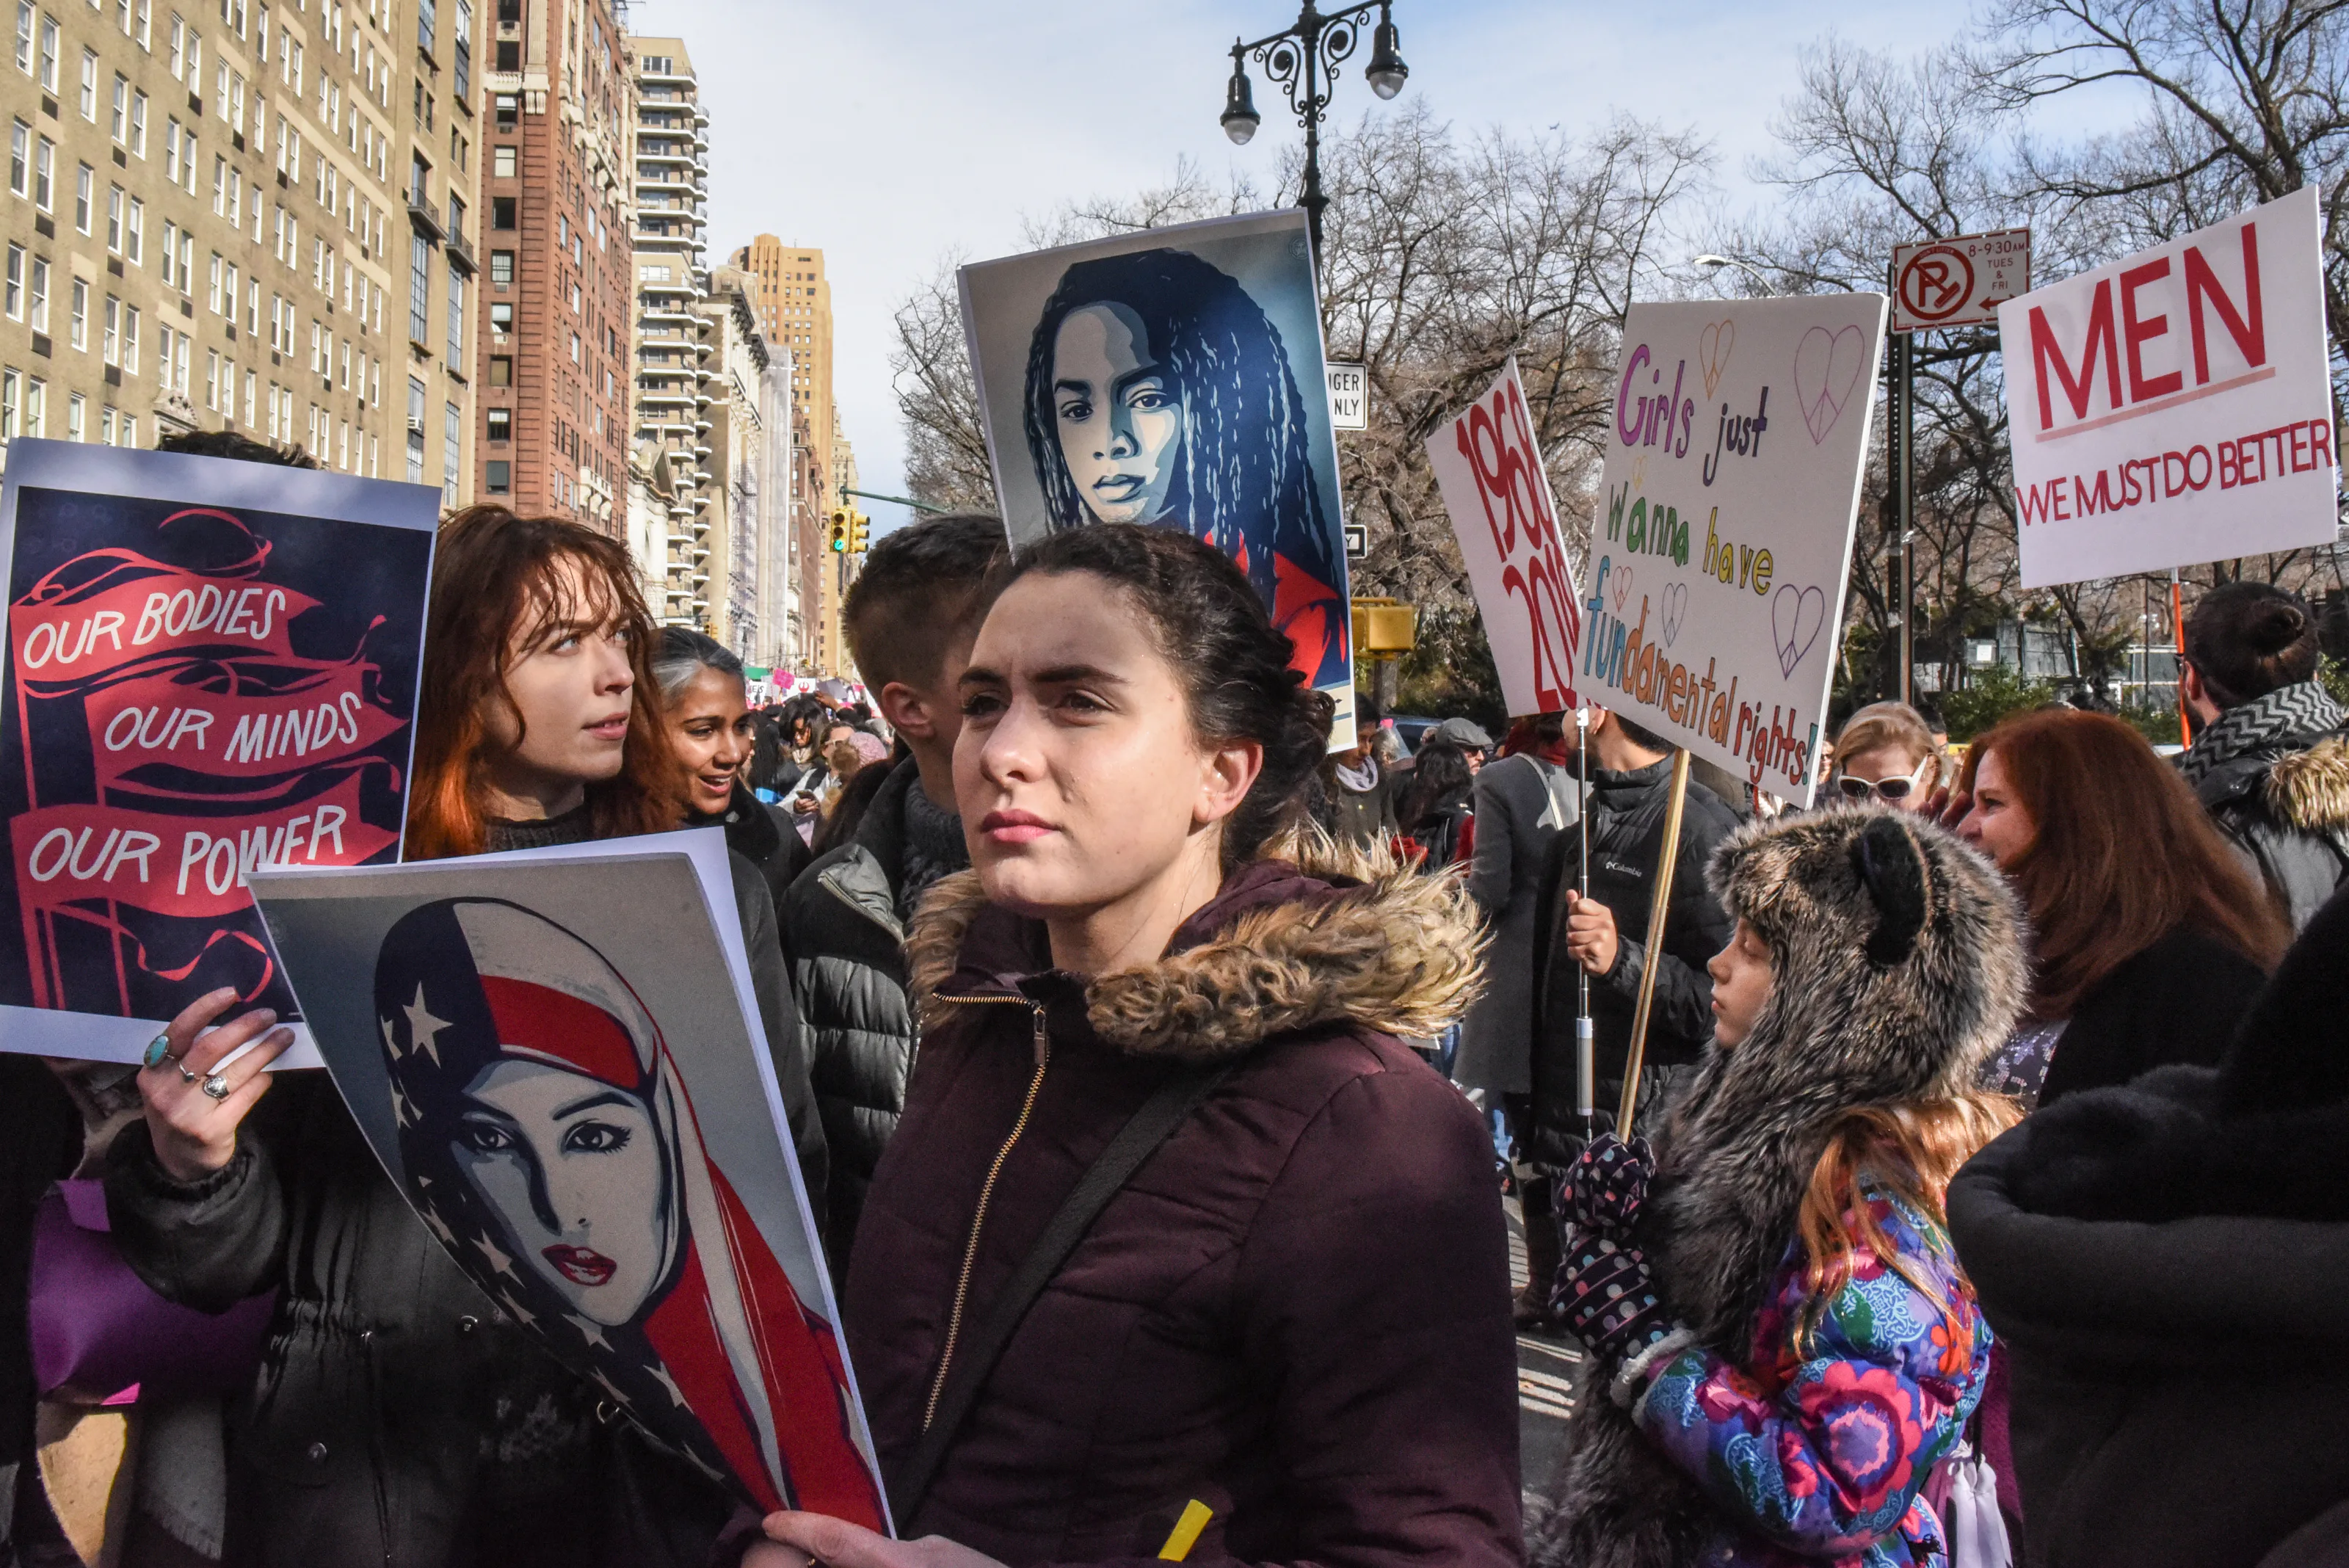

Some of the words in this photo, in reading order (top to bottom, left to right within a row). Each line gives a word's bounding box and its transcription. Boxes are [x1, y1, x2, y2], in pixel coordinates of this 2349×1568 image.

[1988, 258, 2014, 268] TUES
[1992, 280, 2008, 291] FRI
[1997, 270, 2003, 279] &
[2028, 222, 2266, 429] MEN
[1335, 398, 1359, 416] NLY
[1618, 344, 1694, 459] Girls
[1703, 386, 1769, 487] just
[1456, 377, 1556, 563] 1968
[2014, 476, 2071, 526] WE
[2074, 457, 2160, 518] MUST
[2163, 444, 2212, 498] DO
[2217, 418, 2333, 490] BETTER
[1702, 507, 1773, 595] have
[23, 611, 126, 669] OUR
[132, 584, 286, 646] BODIES
[1583, 555, 1738, 747] fundamental
[1733, 702, 1819, 785] rights!
[104, 706, 214, 752] OUR
[223, 692, 362, 764] MINDS
[29, 827, 161, 883] OUR
[176, 805, 347, 896] POWER
[1612, 862, 1642, 877] Columbia
